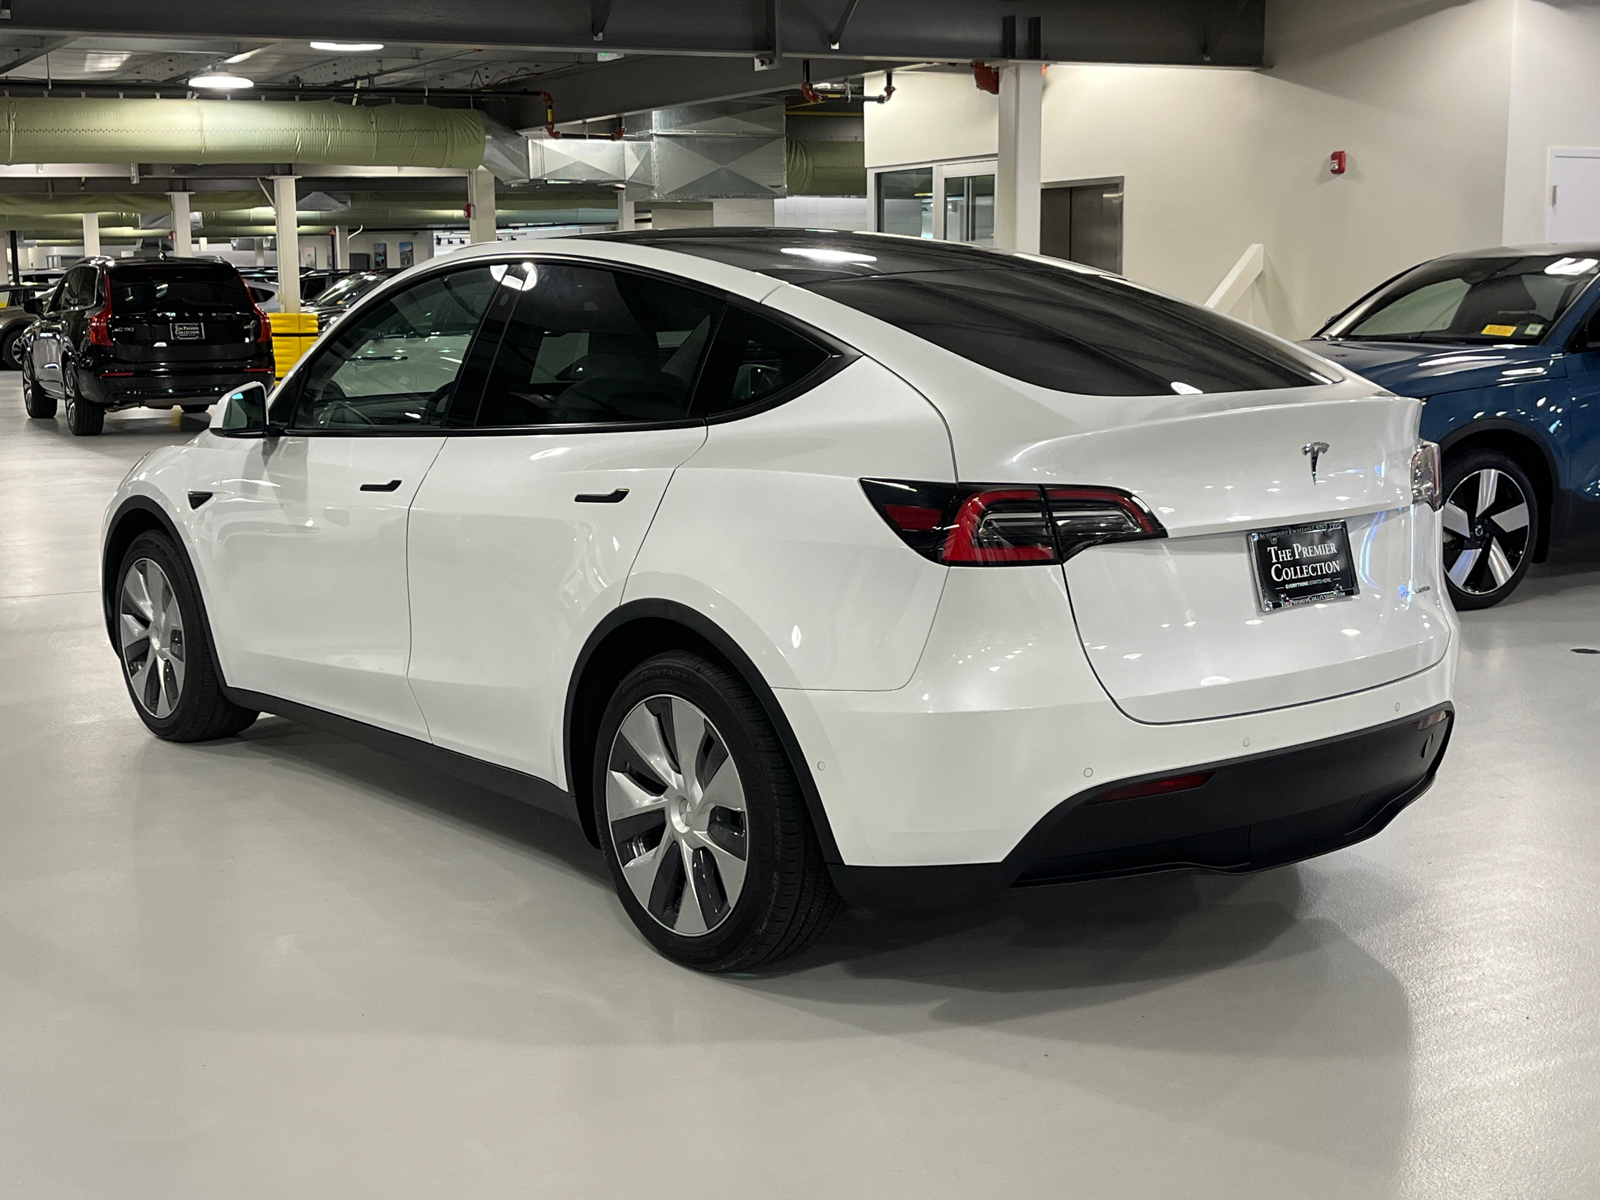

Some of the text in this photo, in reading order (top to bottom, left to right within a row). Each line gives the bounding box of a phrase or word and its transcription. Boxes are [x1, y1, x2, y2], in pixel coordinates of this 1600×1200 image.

[1267, 543, 1338, 563] THE PREMIER
[1271, 560, 1341, 582] COLLECTION
